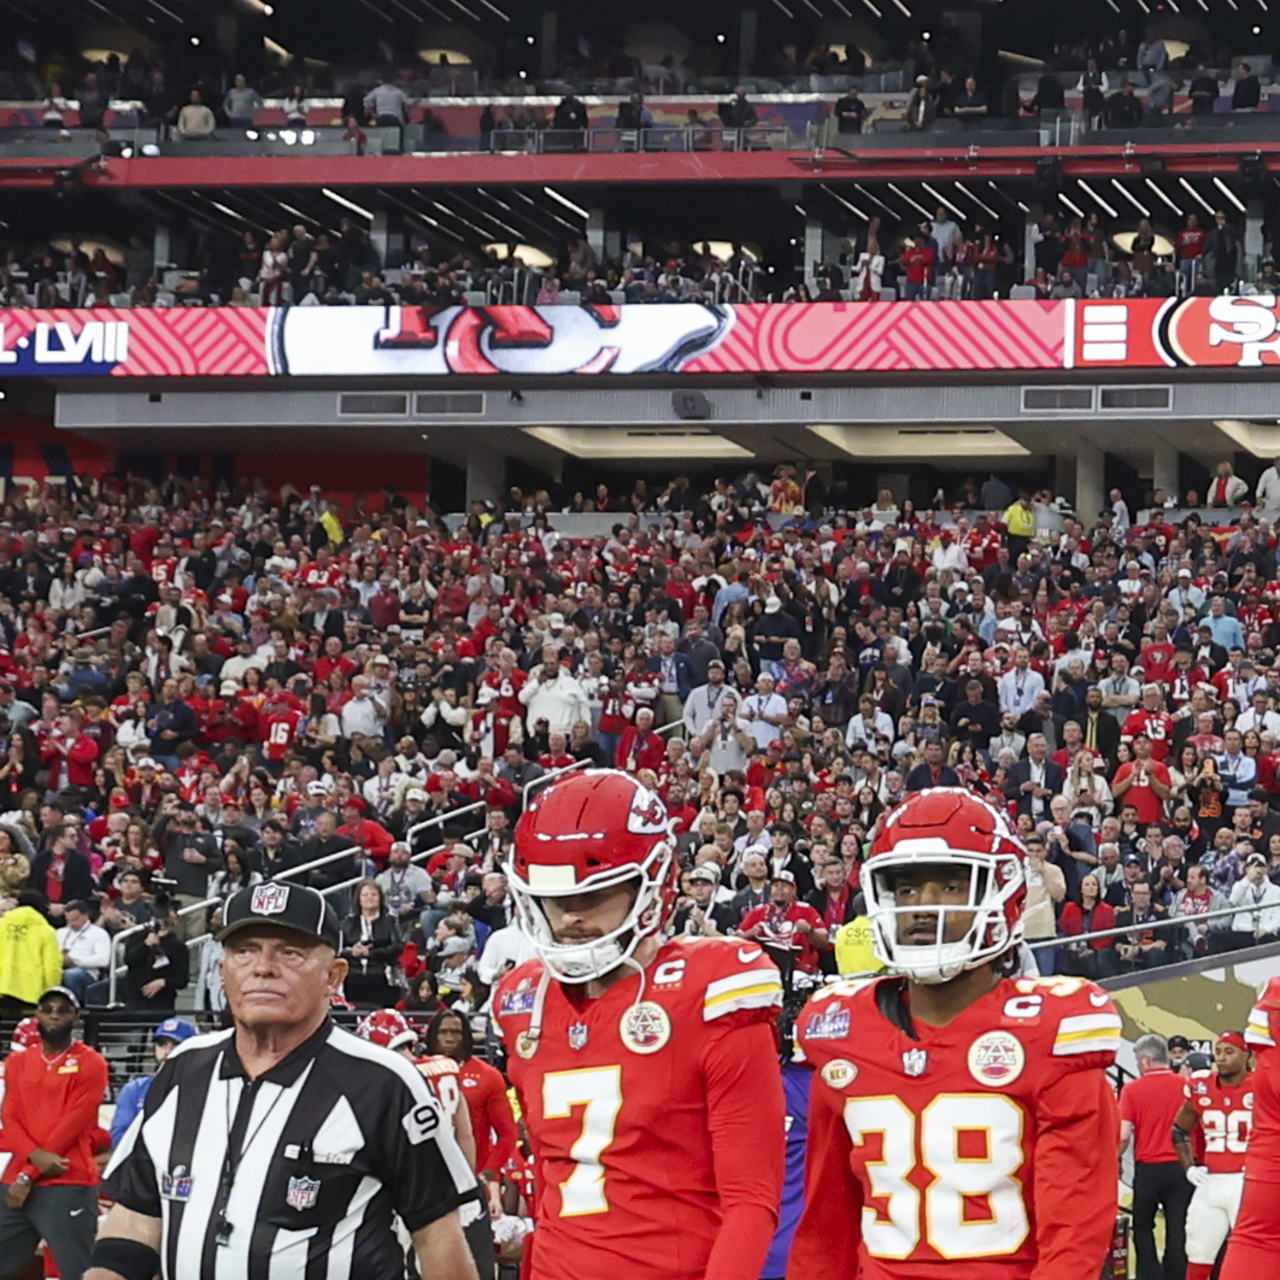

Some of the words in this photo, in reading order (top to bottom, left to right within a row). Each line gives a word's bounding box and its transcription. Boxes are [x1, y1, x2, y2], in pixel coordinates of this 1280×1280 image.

[35, 322, 129, 363] LVIII
[271, 721, 290, 744] 16
[413, 1104, 442, 1136] 9
[541, 1064, 624, 1218] 7
[1201, 1109, 1255, 1154] 20
[843, 1091, 1031, 1260] 38
